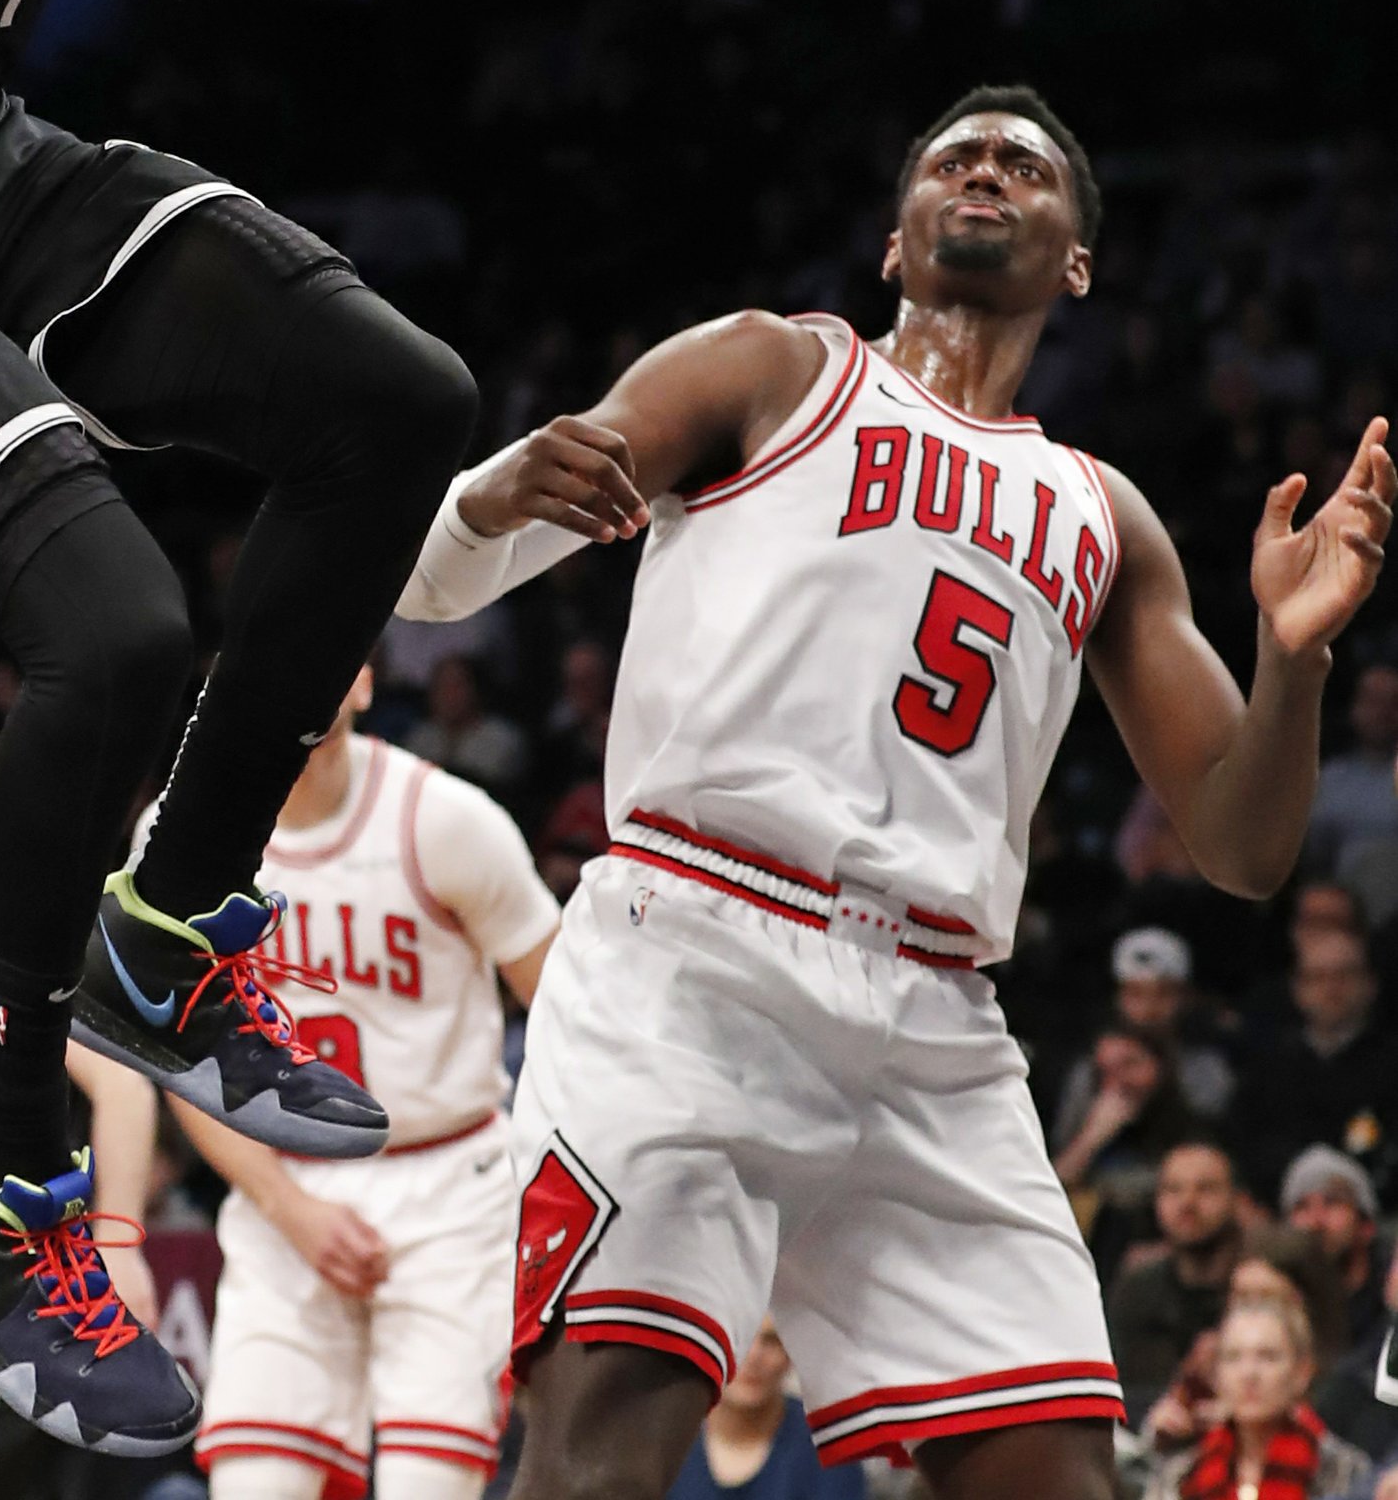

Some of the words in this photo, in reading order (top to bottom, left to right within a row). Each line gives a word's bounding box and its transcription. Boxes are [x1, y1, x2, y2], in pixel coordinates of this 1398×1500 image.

[838, 426, 1104, 662] BULLS
[892, 568, 1015, 759] 5
[256, 902, 423, 1002] ULLS
